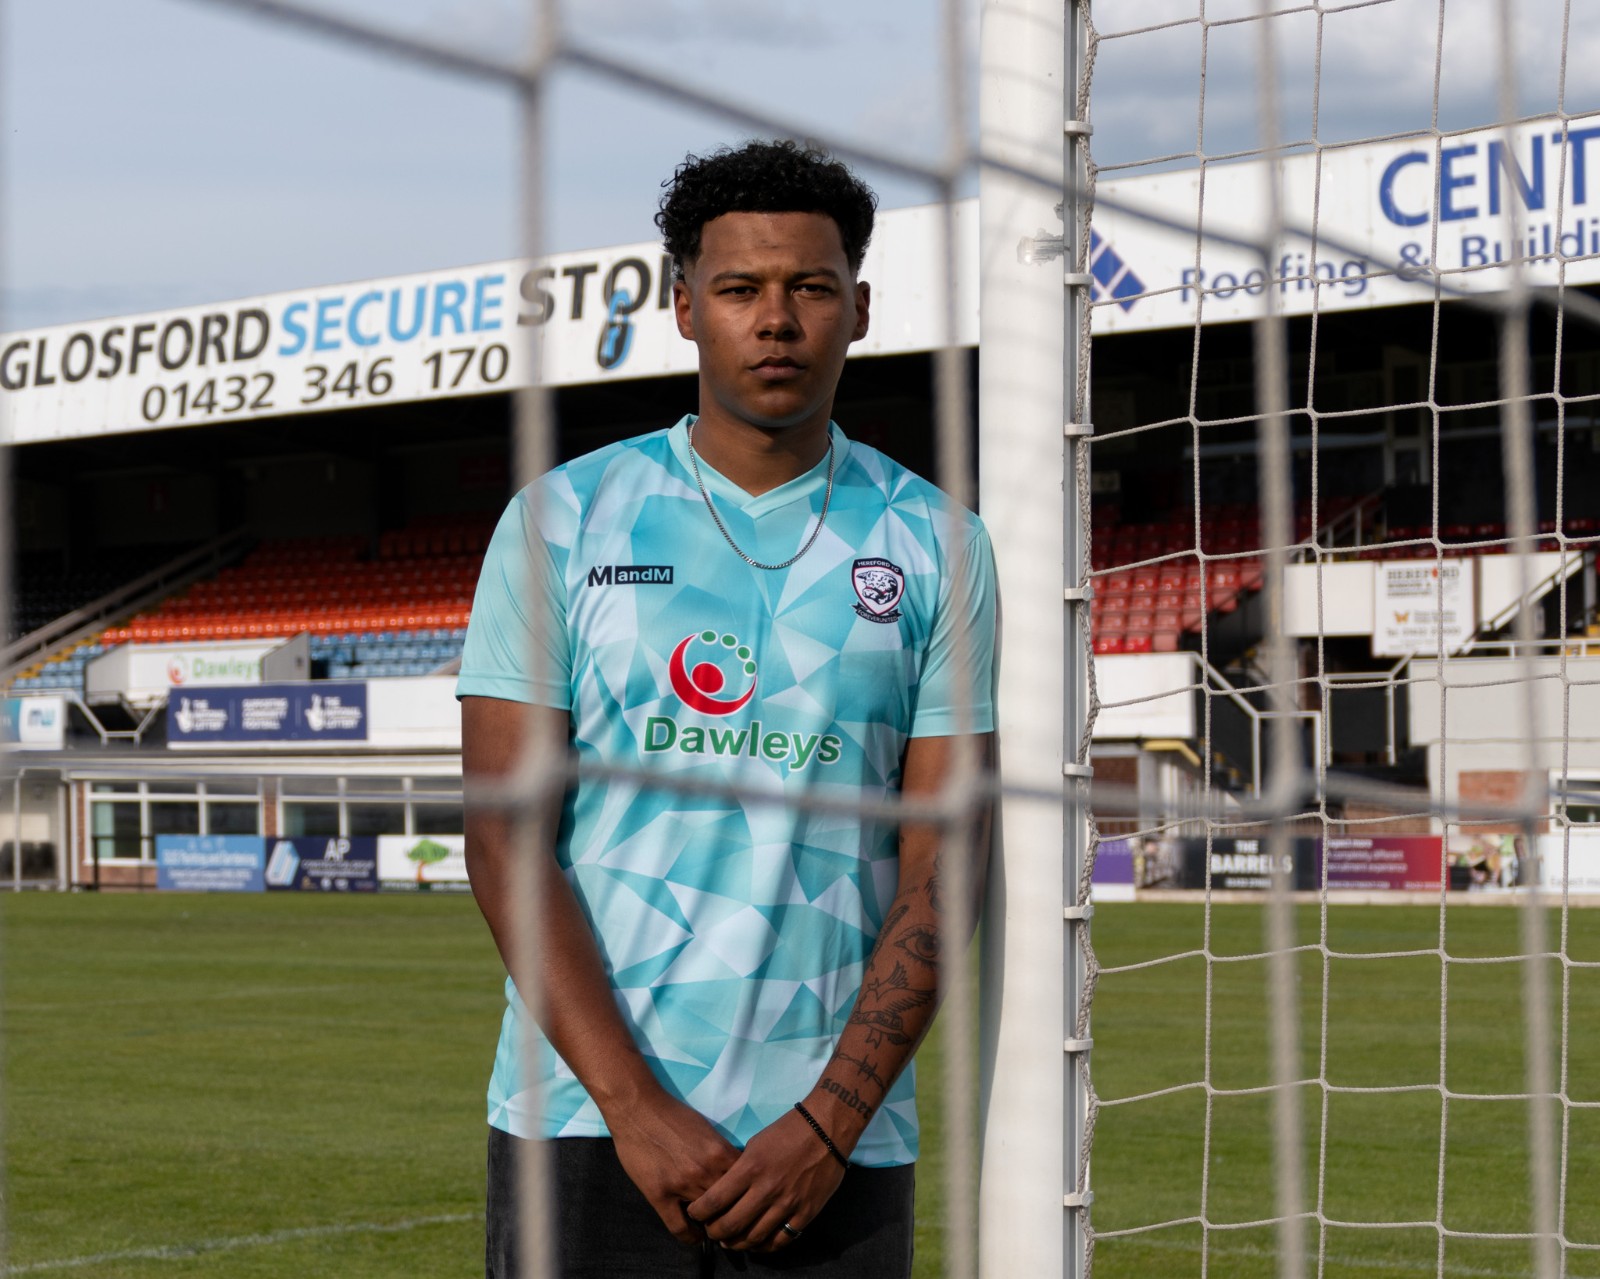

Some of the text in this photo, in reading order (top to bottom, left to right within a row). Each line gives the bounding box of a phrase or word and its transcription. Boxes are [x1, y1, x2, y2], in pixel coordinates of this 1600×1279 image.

[1379, 127, 1600, 227] CENT
[1181, 254, 1368, 303] Roofing
[1397, 242, 1433, 281] &
[0, 308, 271, 391] GLOSFORD
[278, 273, 506, 356] SECURE
[141, 343, 510, 422] 01432 346 170
[857, 560, 891, 568] HEREFORD
[644, 715, 842, 772] Dawleys
[324, 838, 351, 861] AP
[1235, 840, 1259, 853] THE
